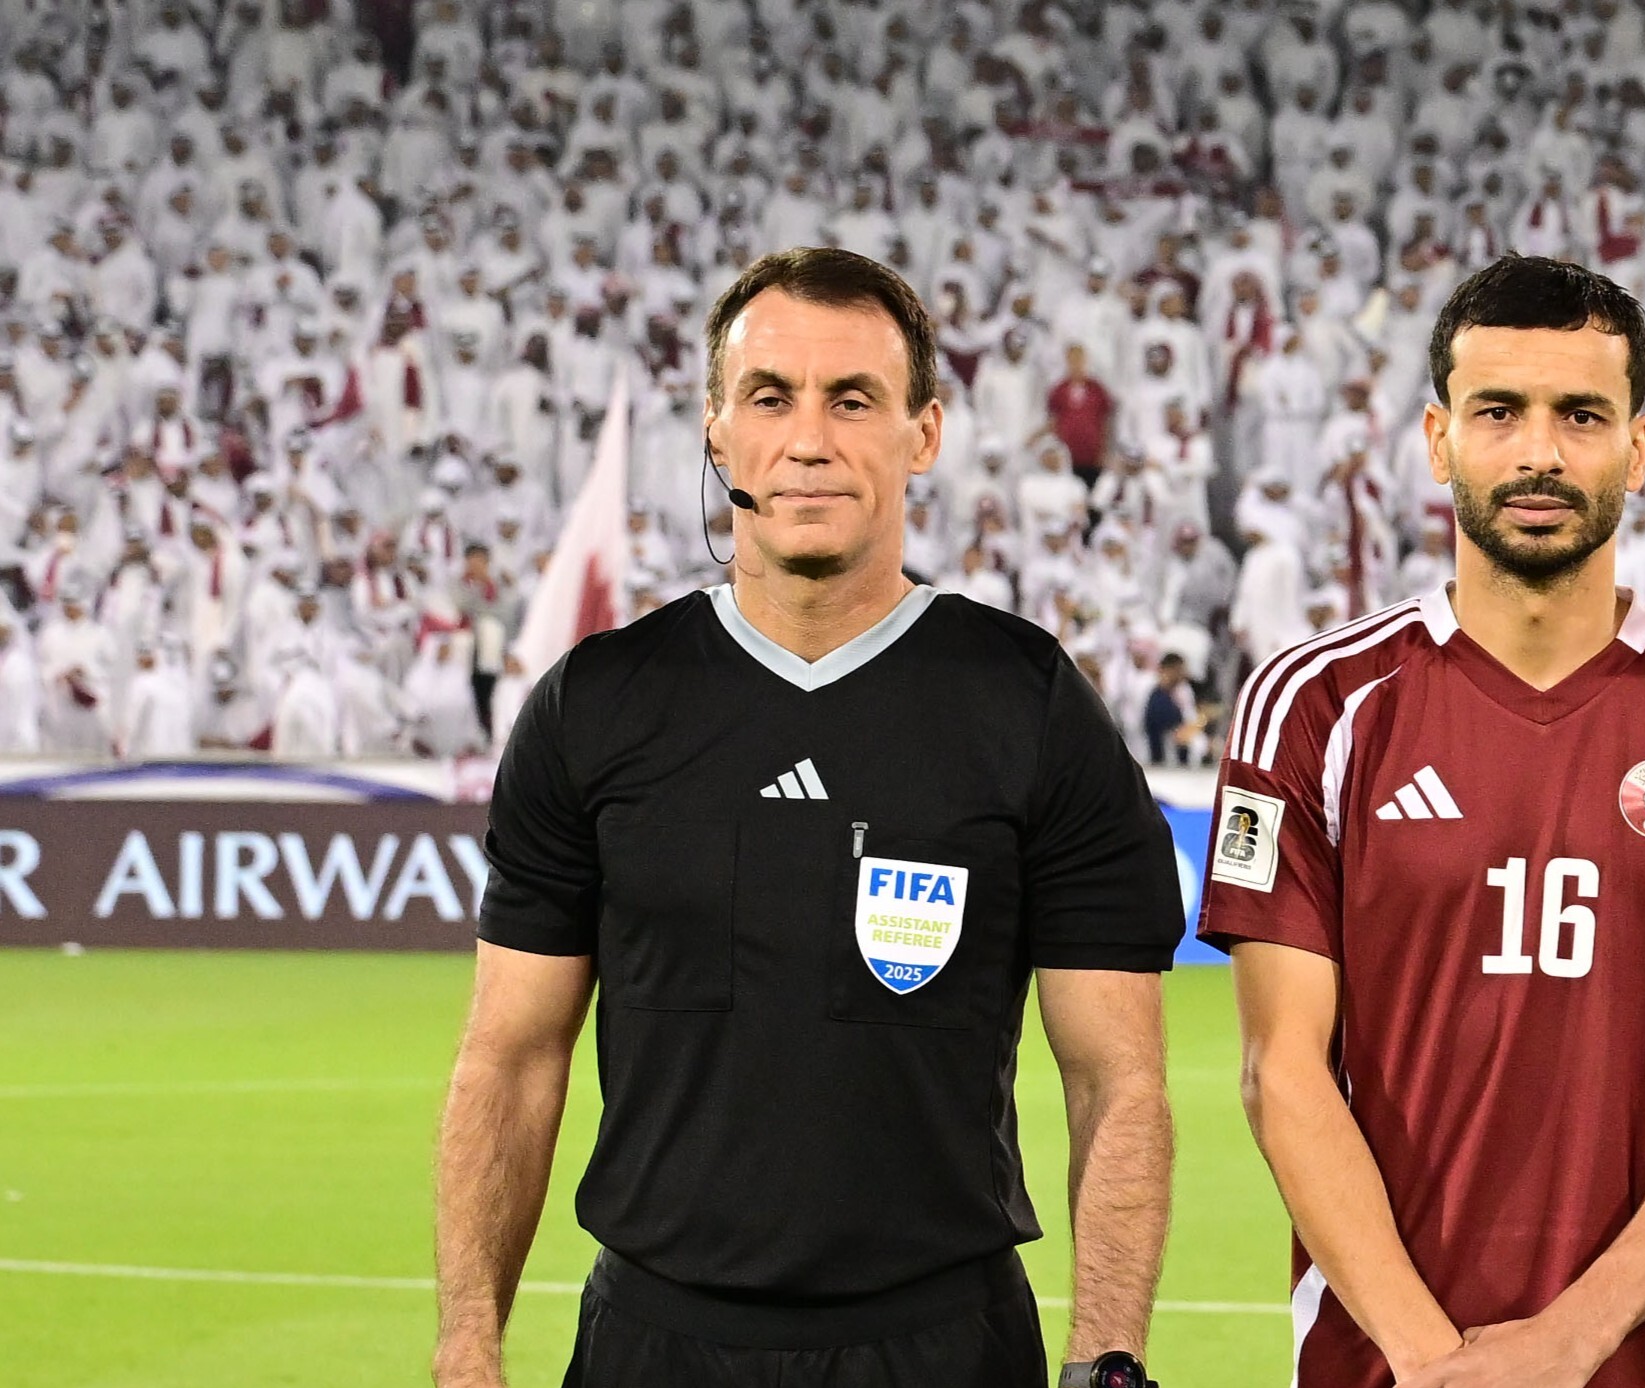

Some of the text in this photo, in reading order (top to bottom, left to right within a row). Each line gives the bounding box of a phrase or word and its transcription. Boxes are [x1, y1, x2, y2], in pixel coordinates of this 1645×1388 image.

[869, 867, 955, 906] FIFA
[867, 913, 952, 934] ASSISTANT
[1482, 857, 1600, 979] 16
[872, 929, 943, 949] REFEREE
[884, 964, 923, 982] 2025
